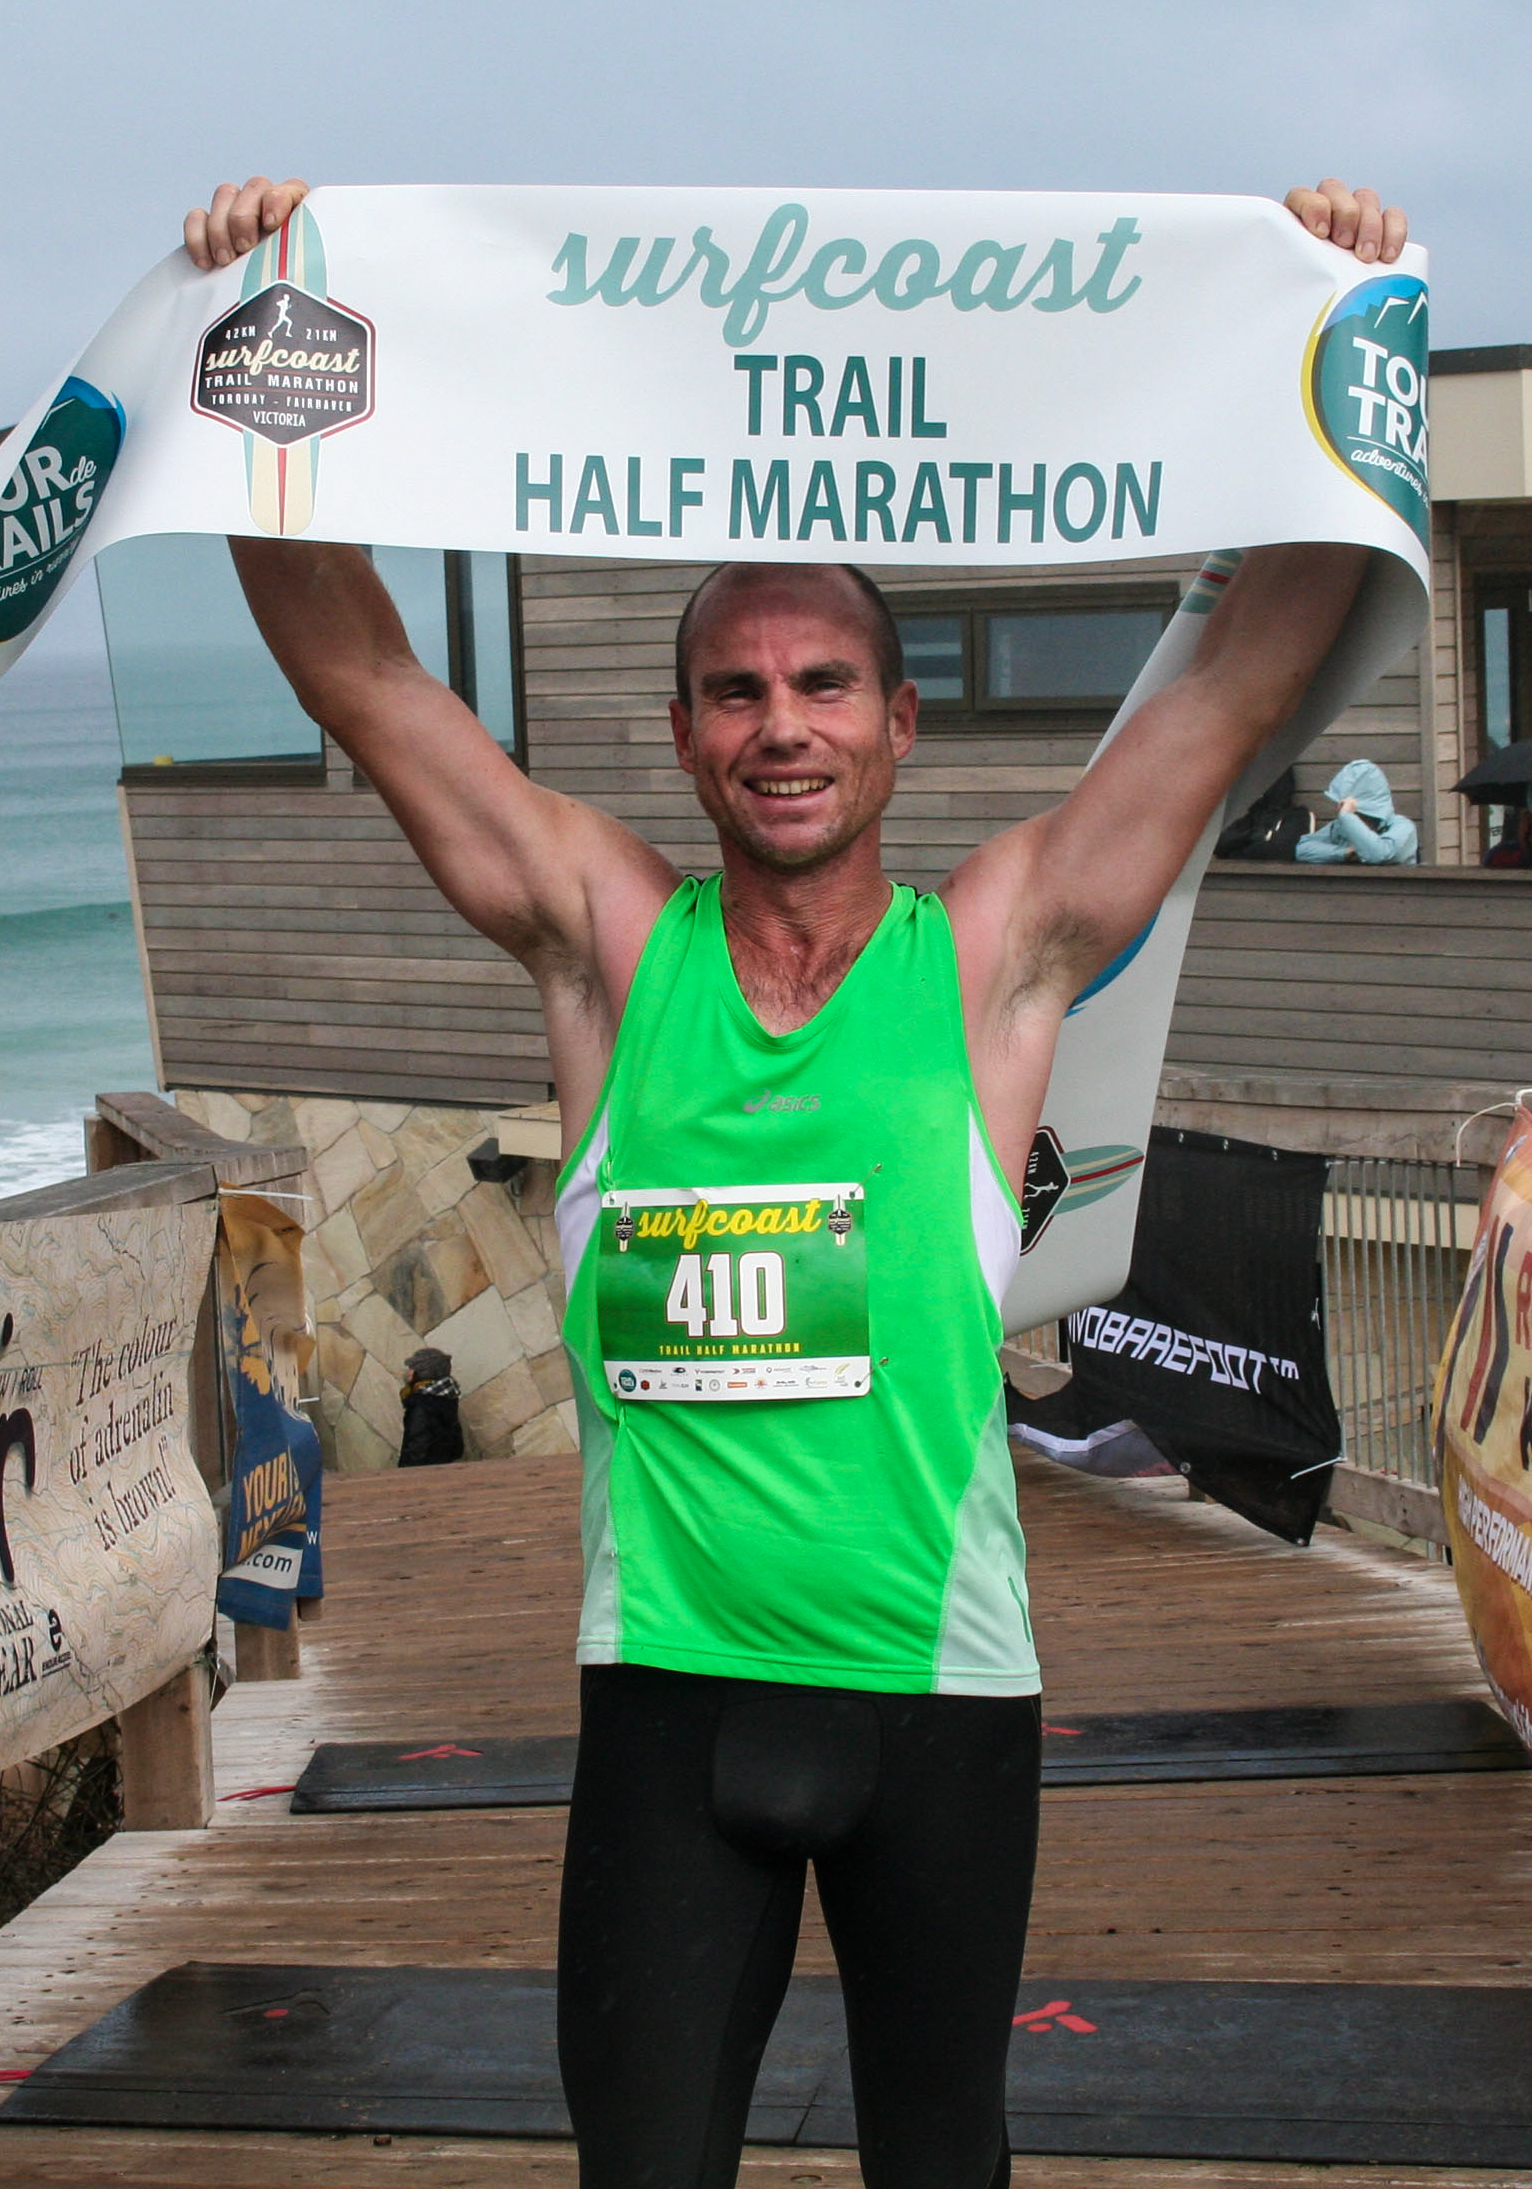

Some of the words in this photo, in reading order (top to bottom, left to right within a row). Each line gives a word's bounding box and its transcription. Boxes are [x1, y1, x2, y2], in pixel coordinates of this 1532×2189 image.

[546, 203, 1143, 347] surfcoast
[205, 339, 360, 375] surfcoast
[205, 374, 252, 388] TRAIL
[268, 374, 359, 393] MARATHON
[212, 394, 266, 405] TORQUAY
[253, 411, 306, 427] VICTORIA
[735, 355, 947, 440] TRAIL
[516, 452, 705, 538] HALF
[729, 460, 1163, 544] MARATHON
[637, 1199, 822, 1249] surfcoast
[666, 1251, 785, 1338] 410
[118, 1313, 178, 1380] colour
[659, 1344, 690, 1355] TRAIL
[696, 1344, 726, 1355] HALF
[731, 1342, 800, 1355] MARATHON
[69, 1416, 89, 1485] of
[95, 1371, 174, 1467] adrenalin
[243, 1452, 288, 1524] YOUR
[89, 1496, 116, 1551] is
